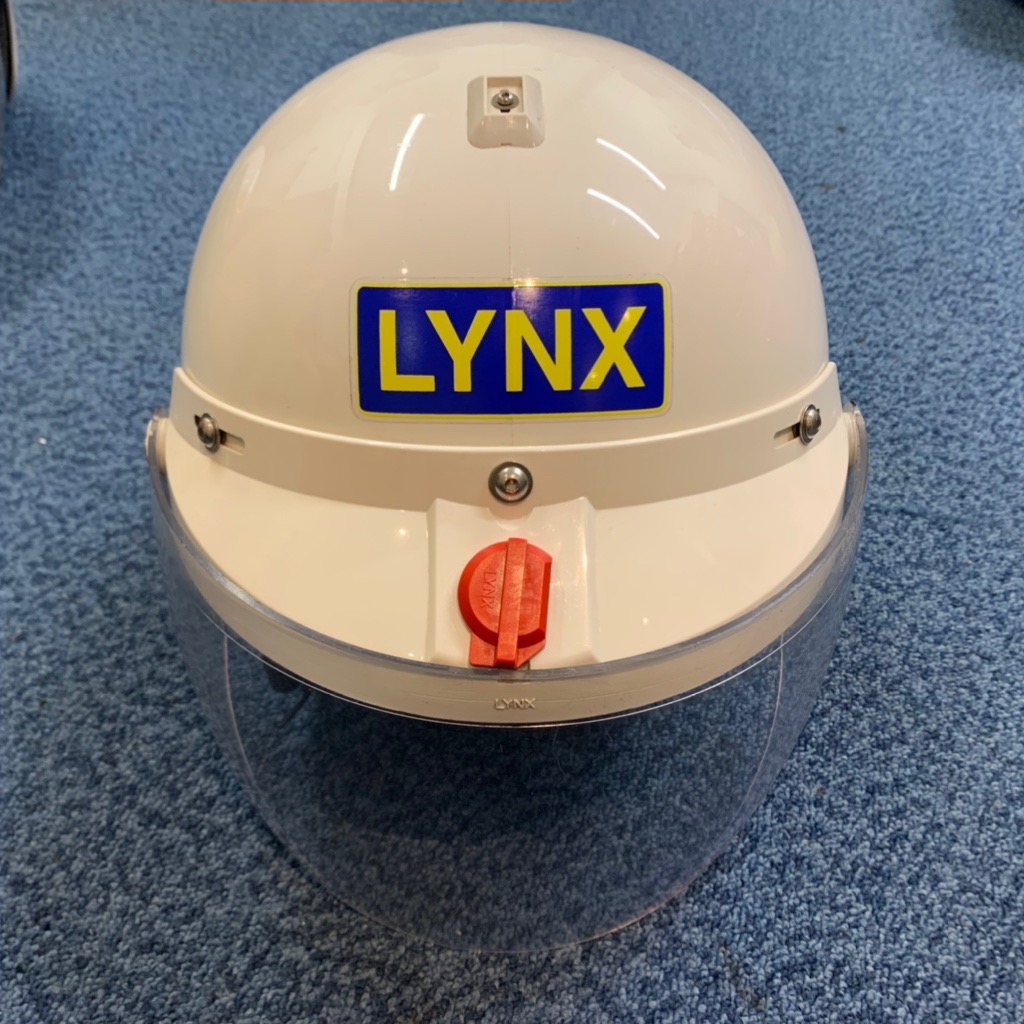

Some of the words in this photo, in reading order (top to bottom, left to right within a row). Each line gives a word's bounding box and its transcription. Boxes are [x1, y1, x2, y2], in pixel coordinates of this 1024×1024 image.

[379, 306, 647, 392] LYNX
[480, 571, 497, 610] LYNX
[494, 697, 536, 711] LYNX
